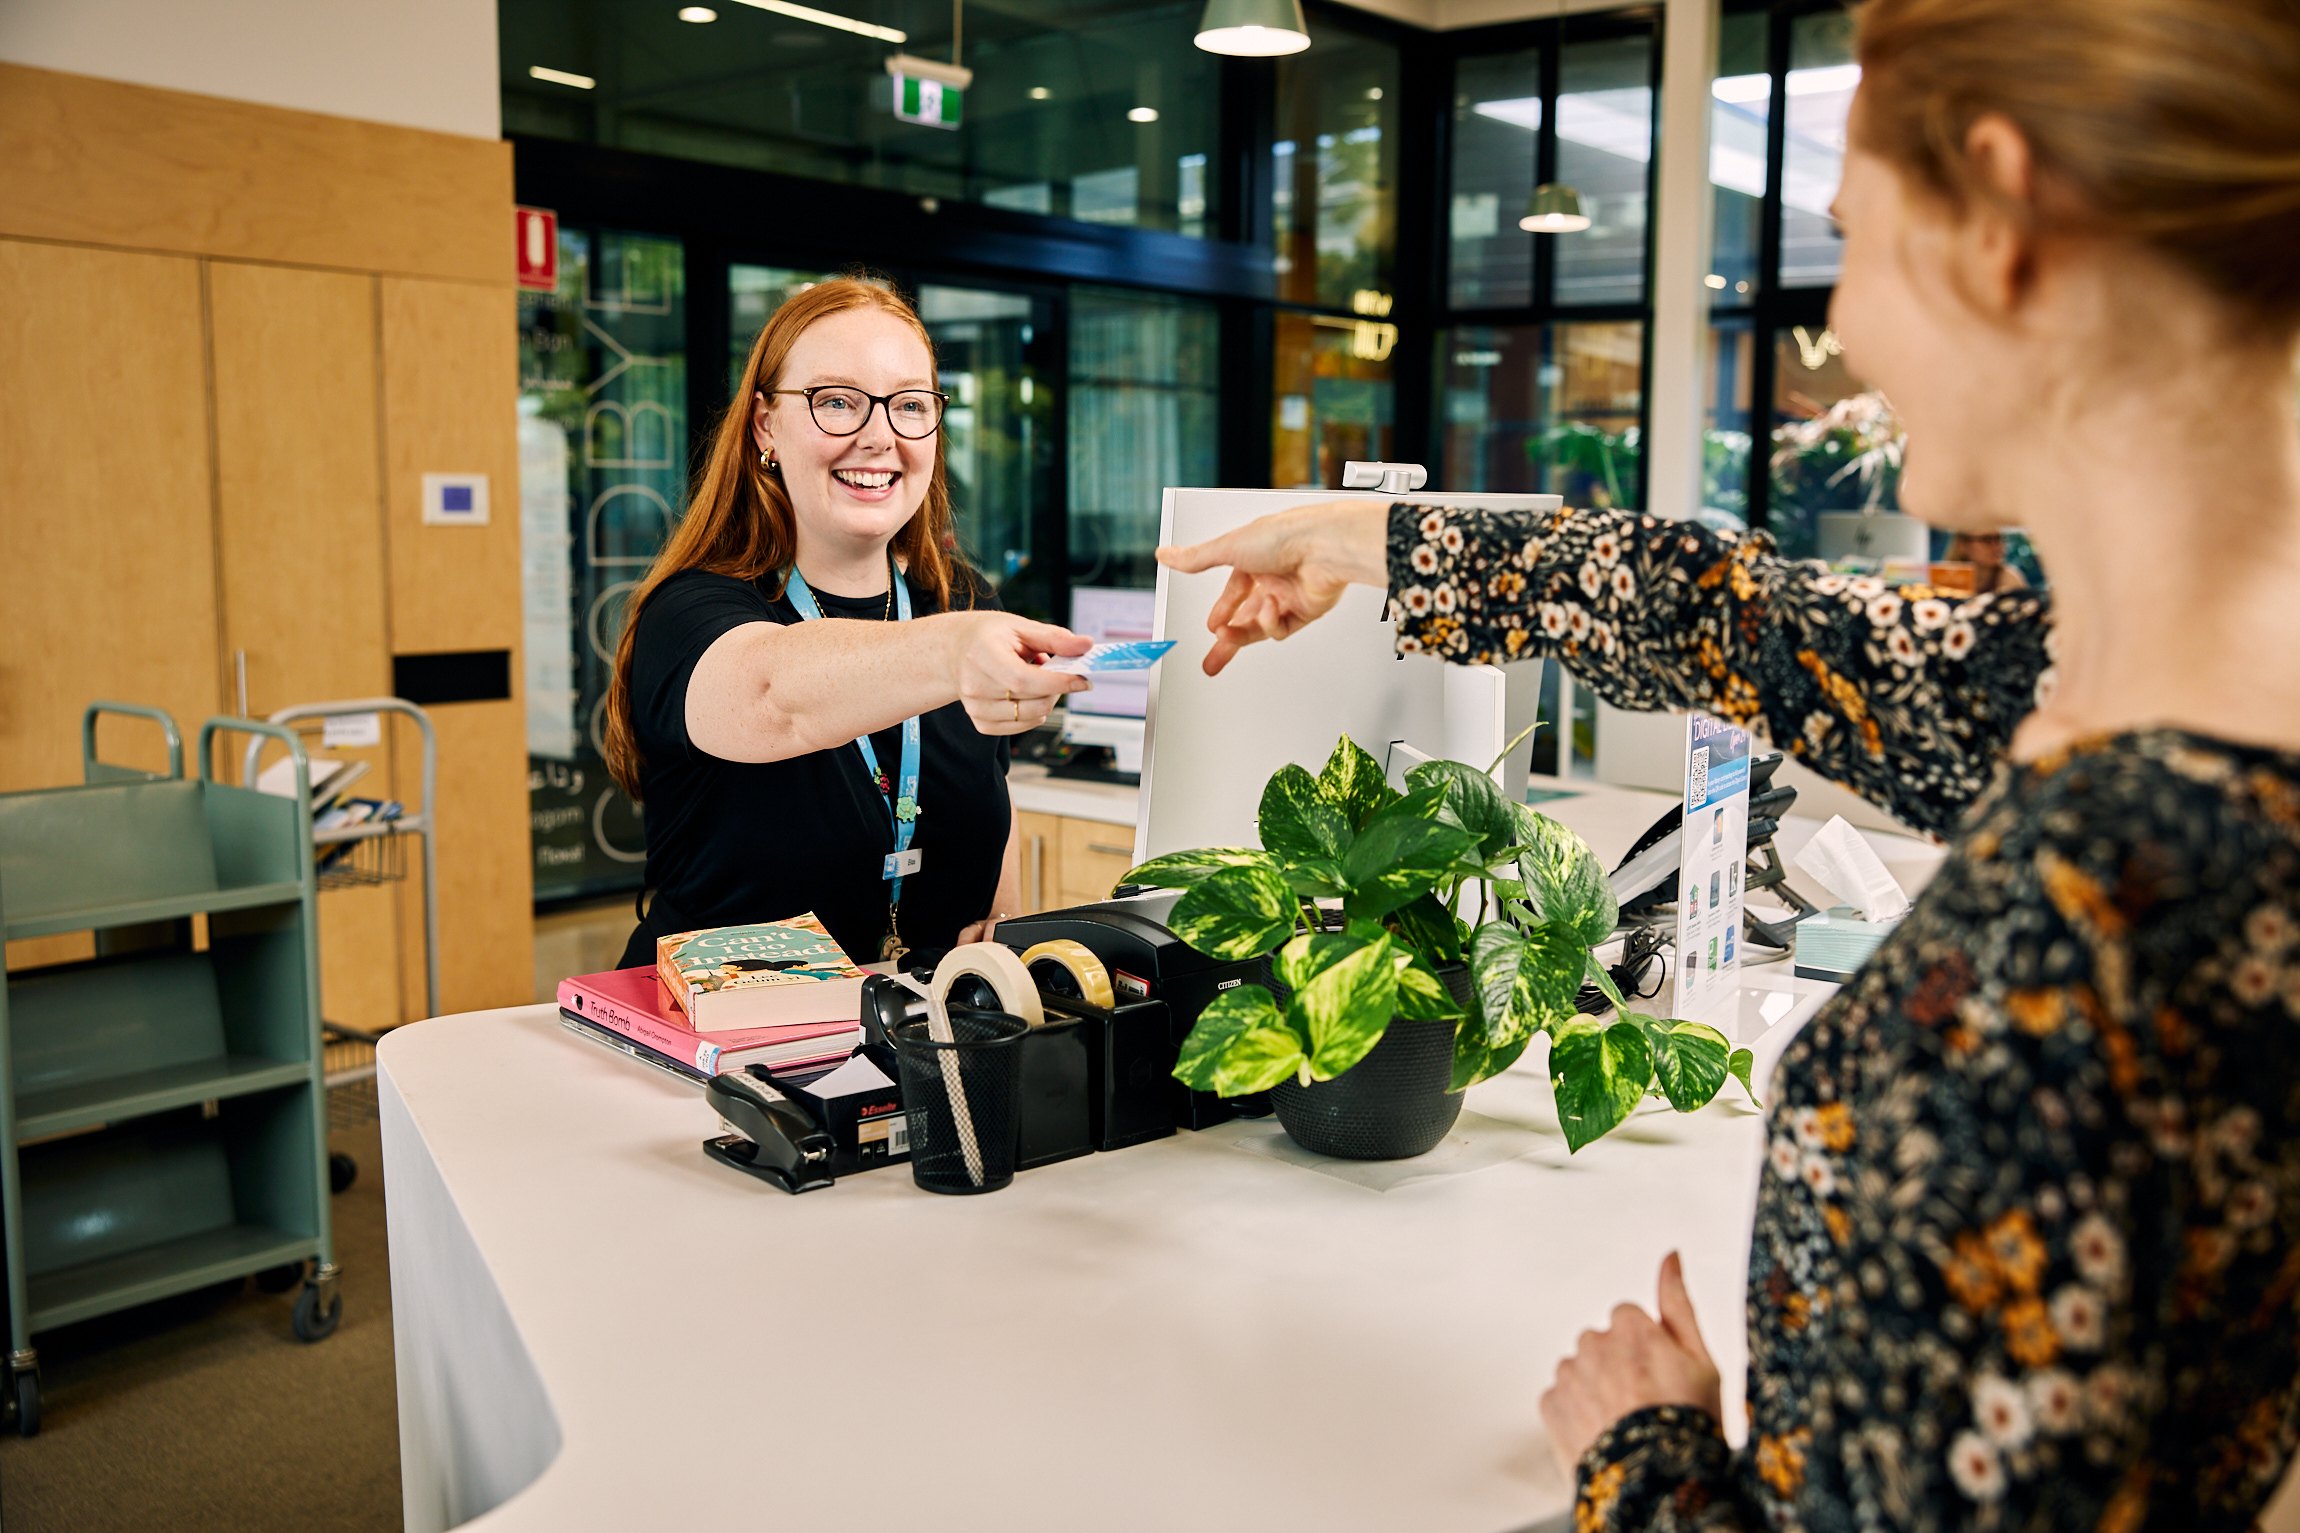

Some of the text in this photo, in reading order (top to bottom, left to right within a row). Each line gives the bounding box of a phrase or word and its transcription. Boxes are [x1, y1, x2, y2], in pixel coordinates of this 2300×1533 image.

[697, 931, 795, 948] Can't
[722, 943, 786, 954] I Go
[688, 943, 829, 966] Instead
[1217, 978, 1242, 990] CITIZEN
[591, 1001, 631, 1031] Truth Bomb
[637, 1025, 672, 1046] Abigail Crompton
